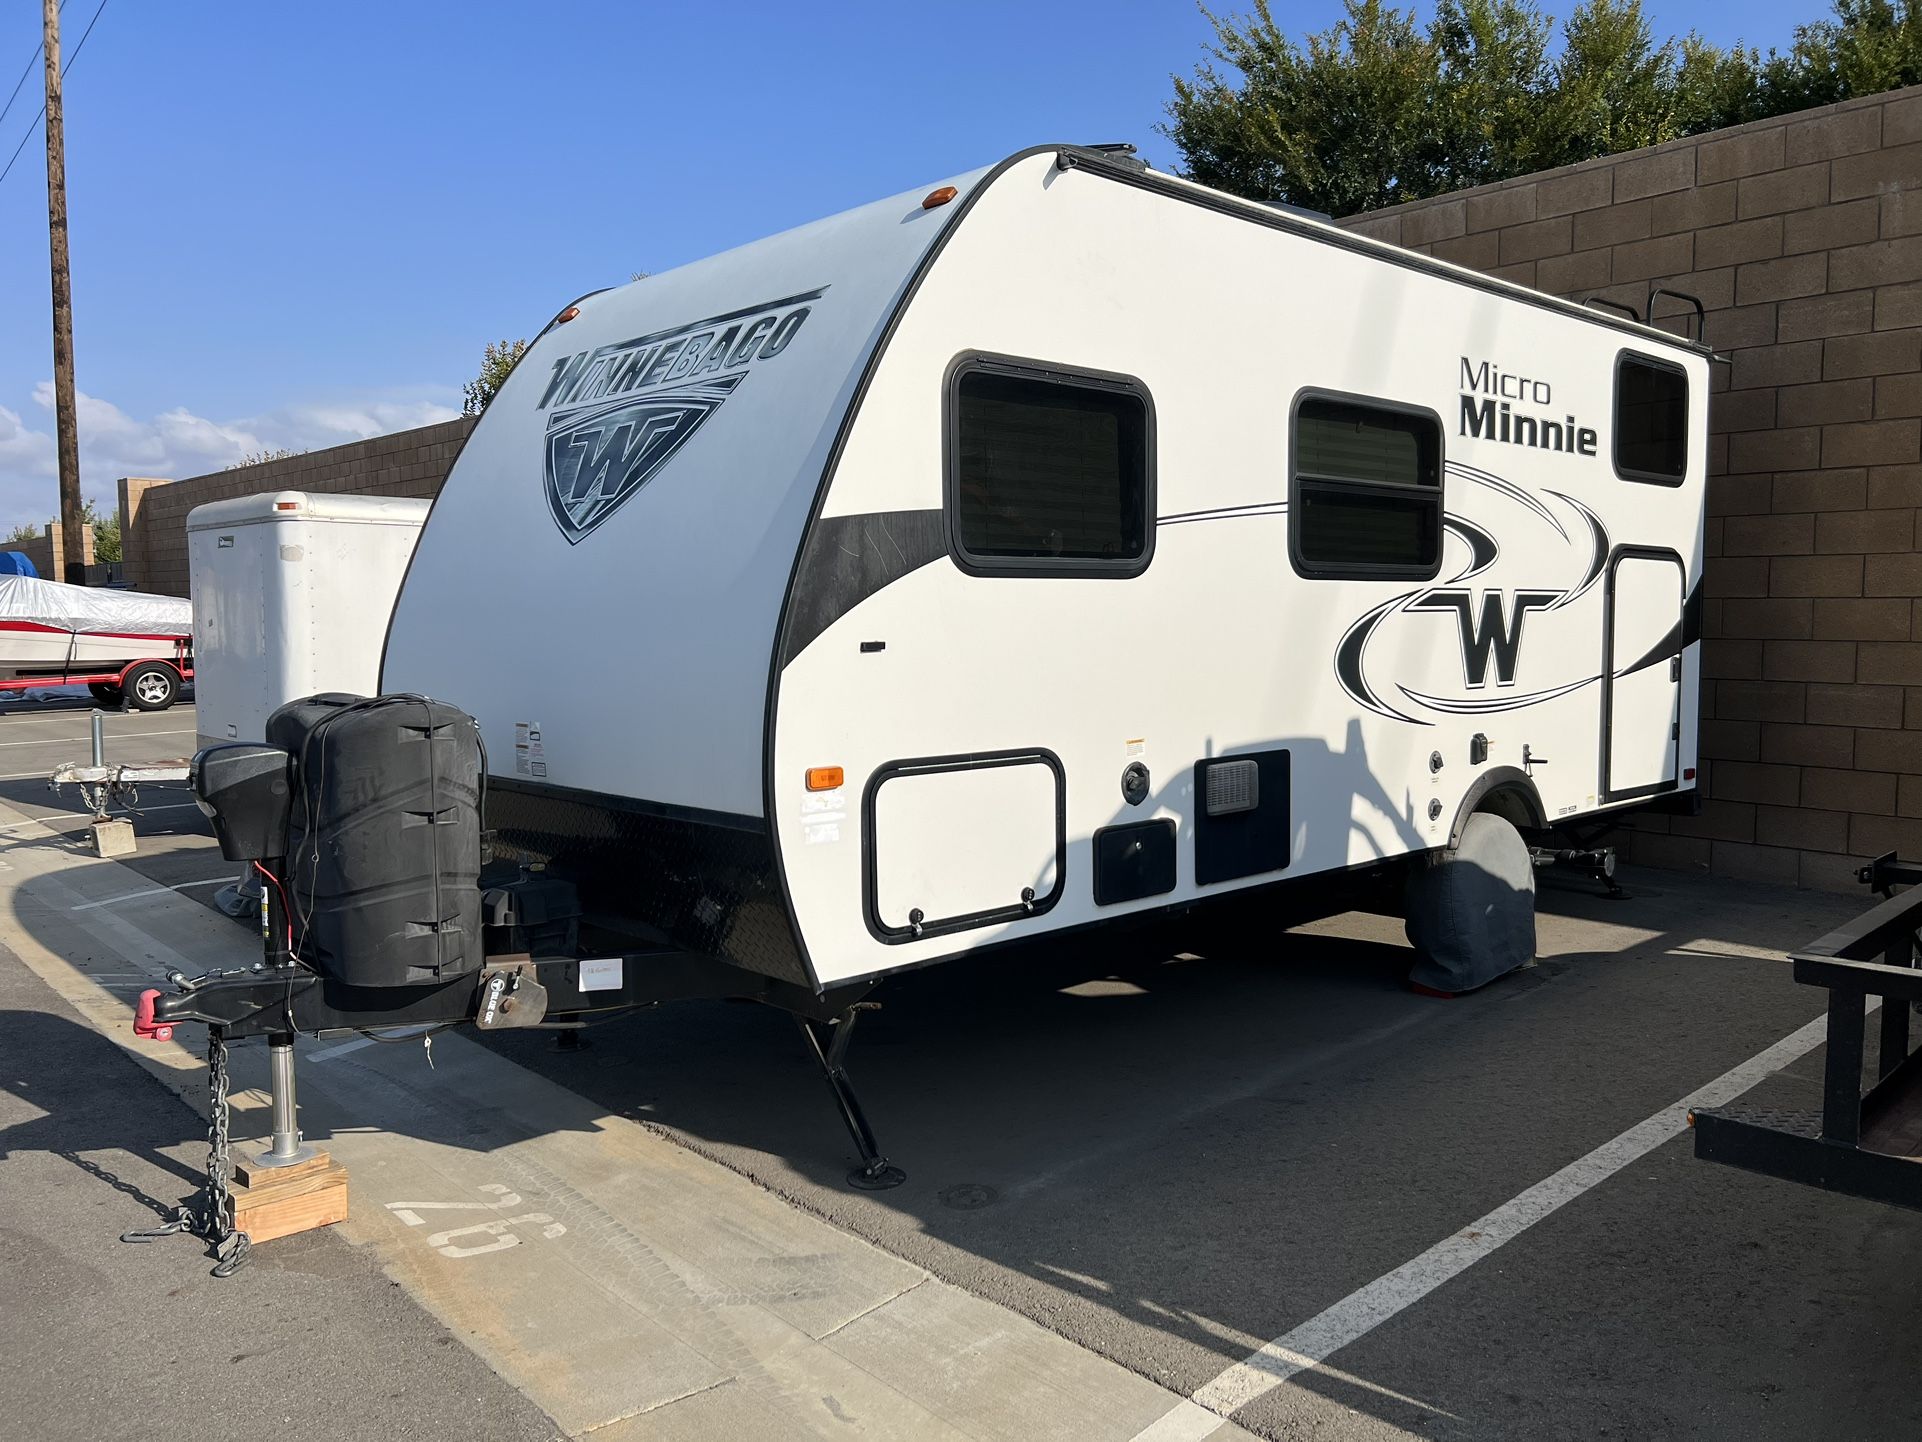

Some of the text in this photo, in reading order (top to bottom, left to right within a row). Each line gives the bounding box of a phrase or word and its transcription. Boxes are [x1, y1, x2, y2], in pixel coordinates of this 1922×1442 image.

[536, 305, 812, 411] WINNEBAGO
[1459, 356, 1551, 405] Micro
[568, 409, 688, 501] W
[1458, 394, 1598, 457] Minnie
[1401, 588, 1570, 689] W
[484, 1011, 494, 1024] OX
